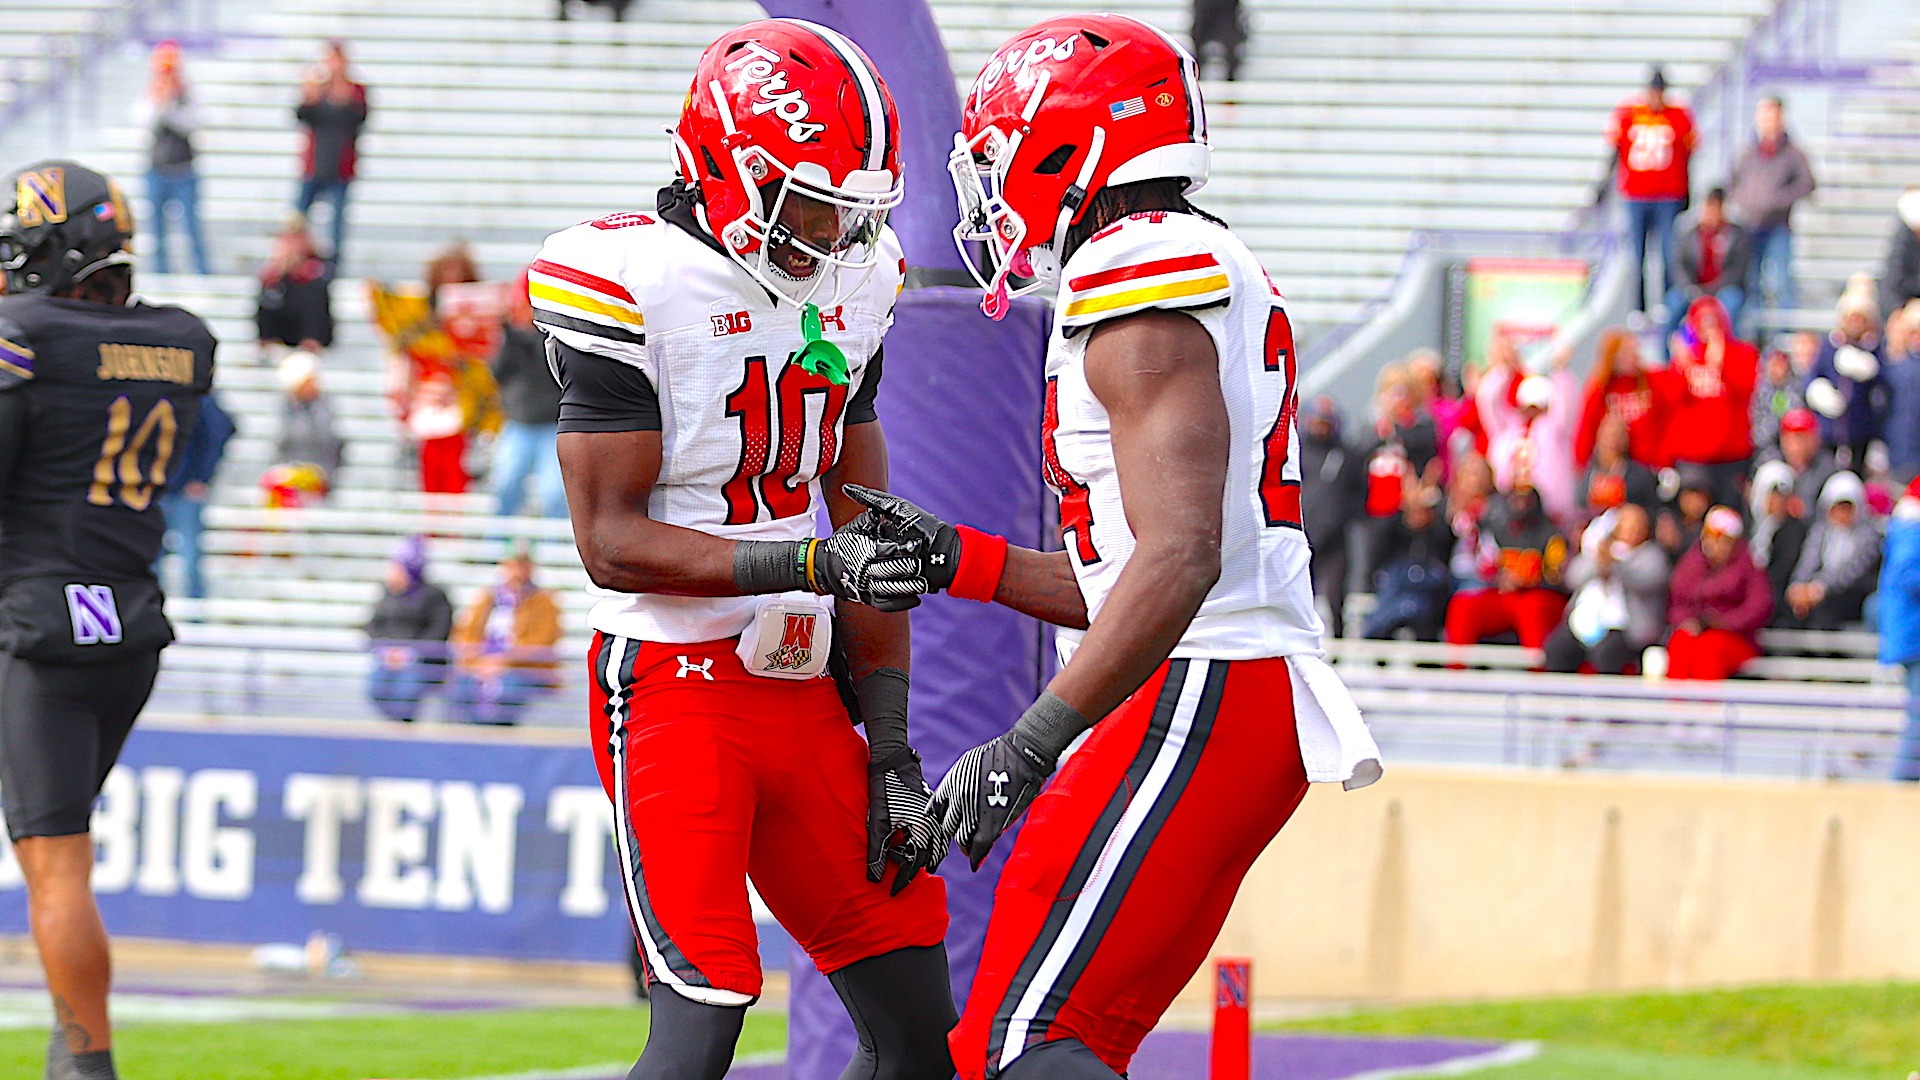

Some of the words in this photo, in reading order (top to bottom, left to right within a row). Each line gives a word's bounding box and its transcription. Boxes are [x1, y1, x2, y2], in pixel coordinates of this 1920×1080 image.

[724, 41, 825, 143] Terps
[17, 166, 67, 228] N
[97, 342, 194, 385] JOHNSON
[88, 394, 177, 511] 10
[721, 352, 850, 525] 10
[797, 543, 808, 563] HOPE
[63, 583, 123, 645] N
[779, 613, 816, 652] M
[89, 763, 258, 901] BIG
[283, 773, 524, 916] TEN
[1217, 965, 1248, 1008] N
